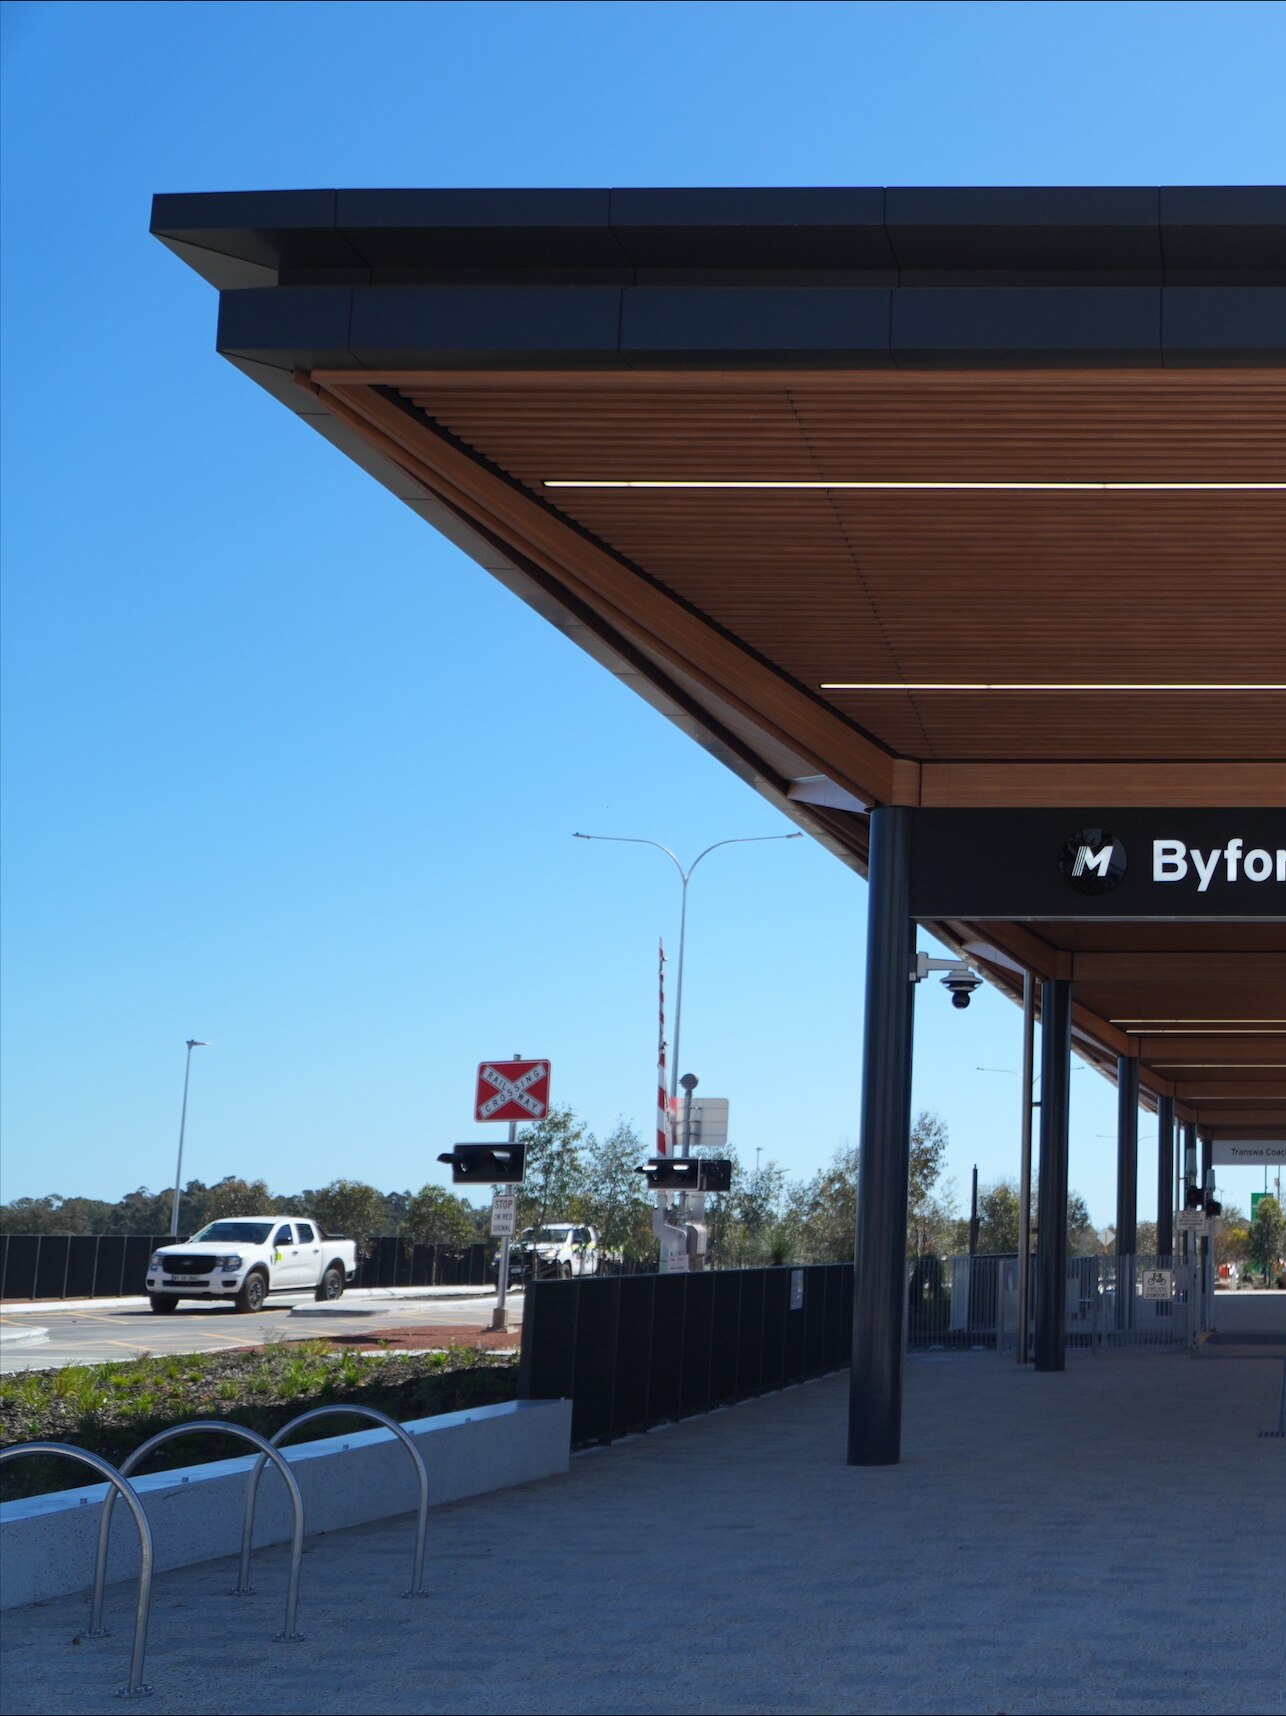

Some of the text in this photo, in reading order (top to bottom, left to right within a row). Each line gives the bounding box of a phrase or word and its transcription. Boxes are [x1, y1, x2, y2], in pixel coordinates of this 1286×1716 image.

[485, 1070, 539, 1113] CROSSING
[1231, 1147, 1263, 1157] Transwa
[494, 1200, 513, 1210] STOP
[502, 1213, 513, 1221] RED
